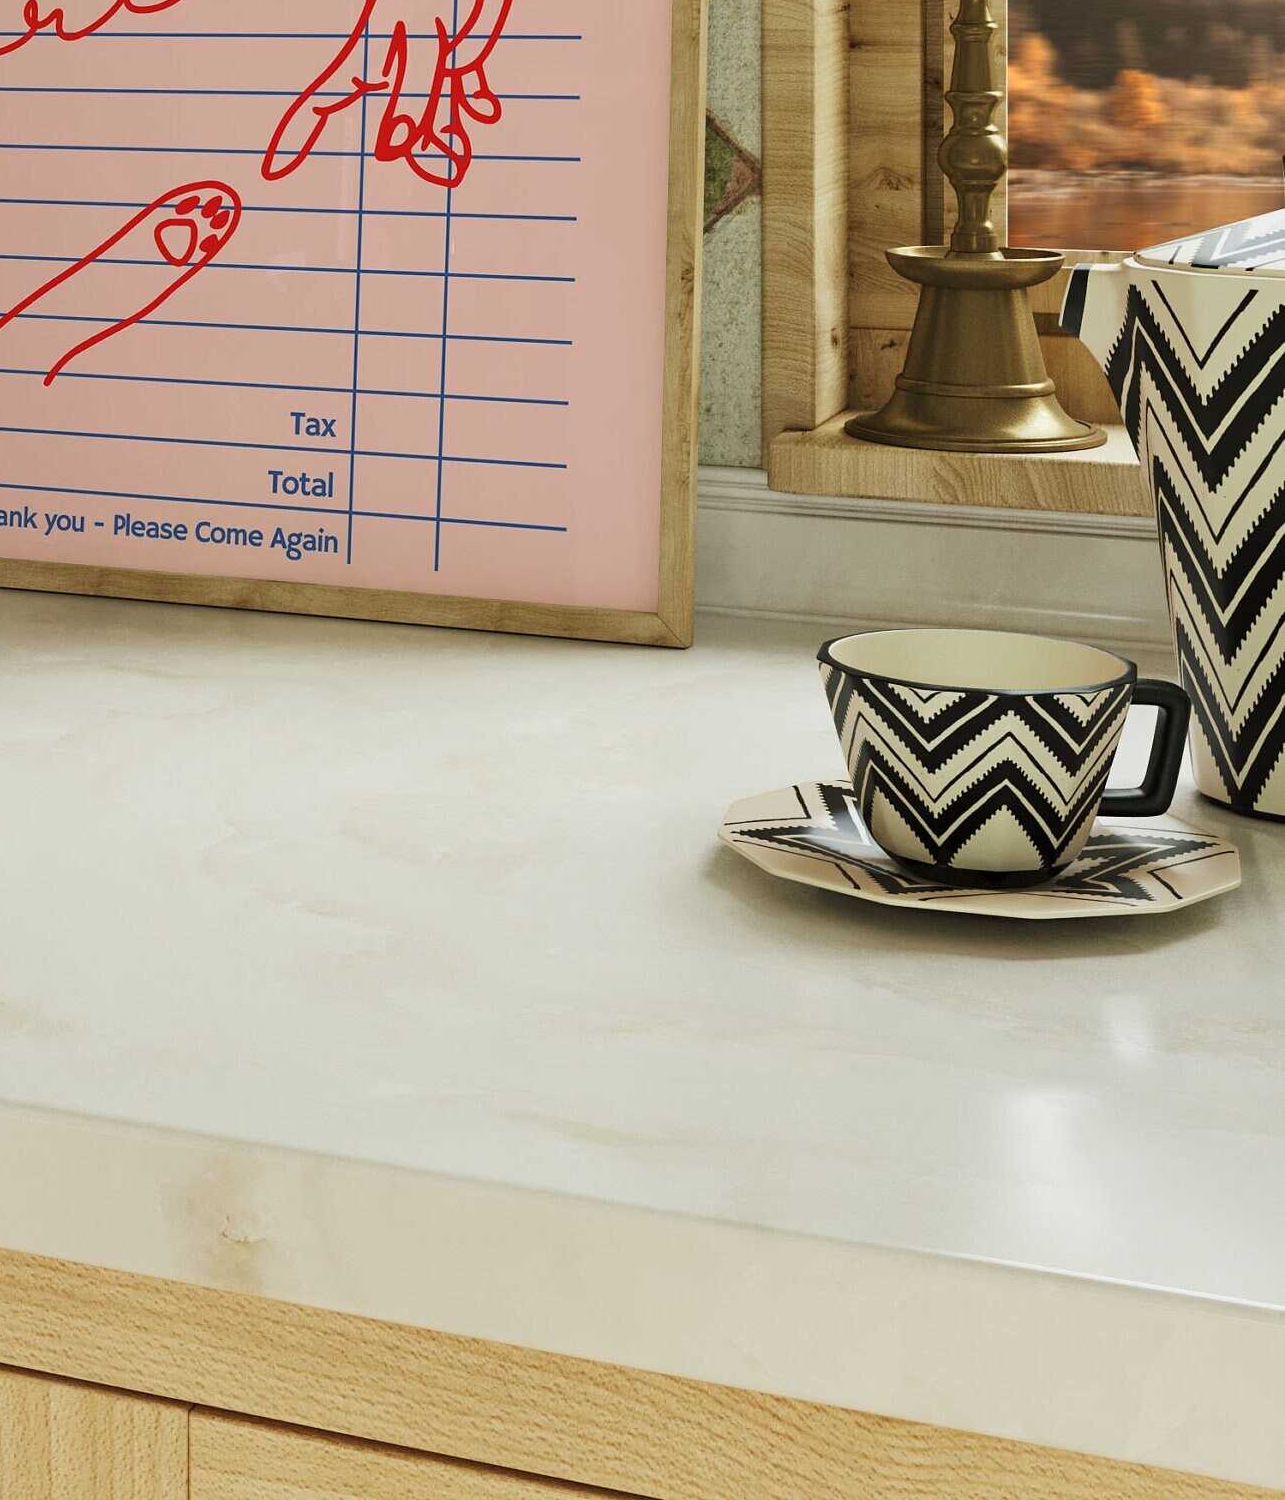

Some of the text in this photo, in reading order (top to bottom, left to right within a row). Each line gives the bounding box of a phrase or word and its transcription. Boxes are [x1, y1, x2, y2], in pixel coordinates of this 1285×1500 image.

[290, 411, 337, 438] Tax
[267, 469, 334, 498] Total
[44, 513, 85, 536] you
[113, 512, 189, 542] Please
[195, 521, 264, 547] Come
[269, 527, 339, 561] Again
